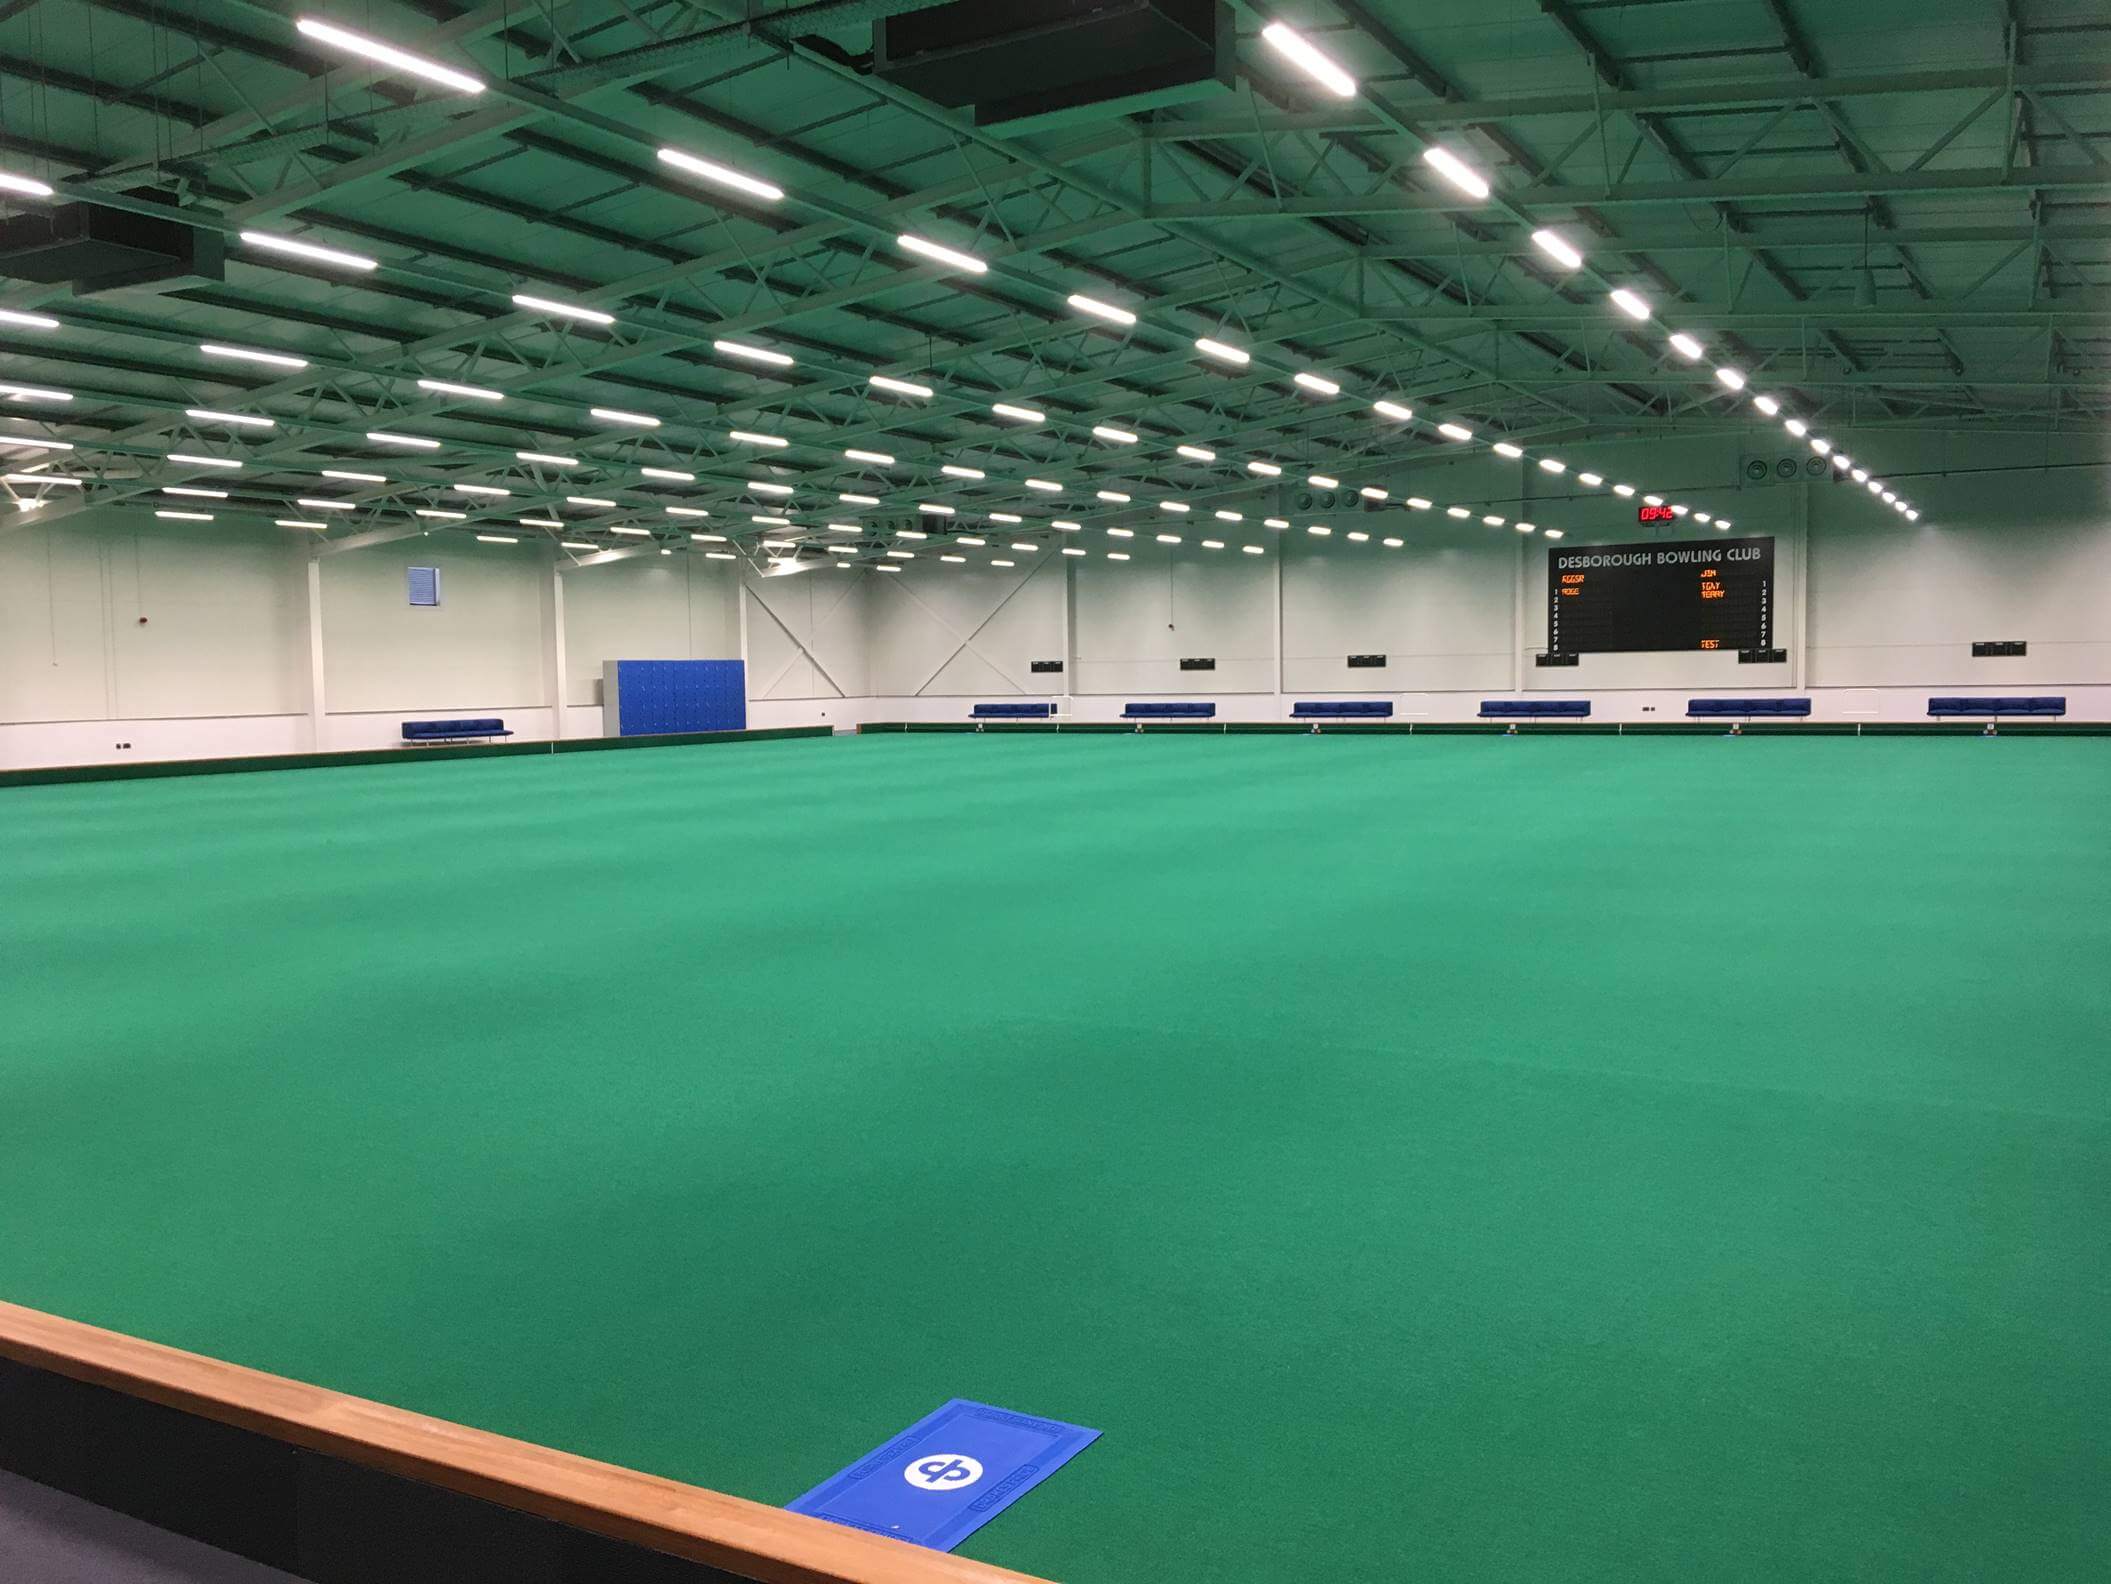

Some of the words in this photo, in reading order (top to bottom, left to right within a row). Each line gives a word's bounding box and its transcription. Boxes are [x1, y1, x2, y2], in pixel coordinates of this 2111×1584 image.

[1558, 553, 1652, 569] DESBOROUGH
[1657, 549, 1722, 565] BOWLING
[1727, 547, 1762, 561] CLUB
[1553, 596, 1559, 604] 2
[1761, 597, 1767, 605] 3
[1761, 622, 1767, 630] 6
[1553, 628, 1559, 636] 6
[1760, 630, 1766, 638] 7
[1701, 640, 1720, 648] TEST
